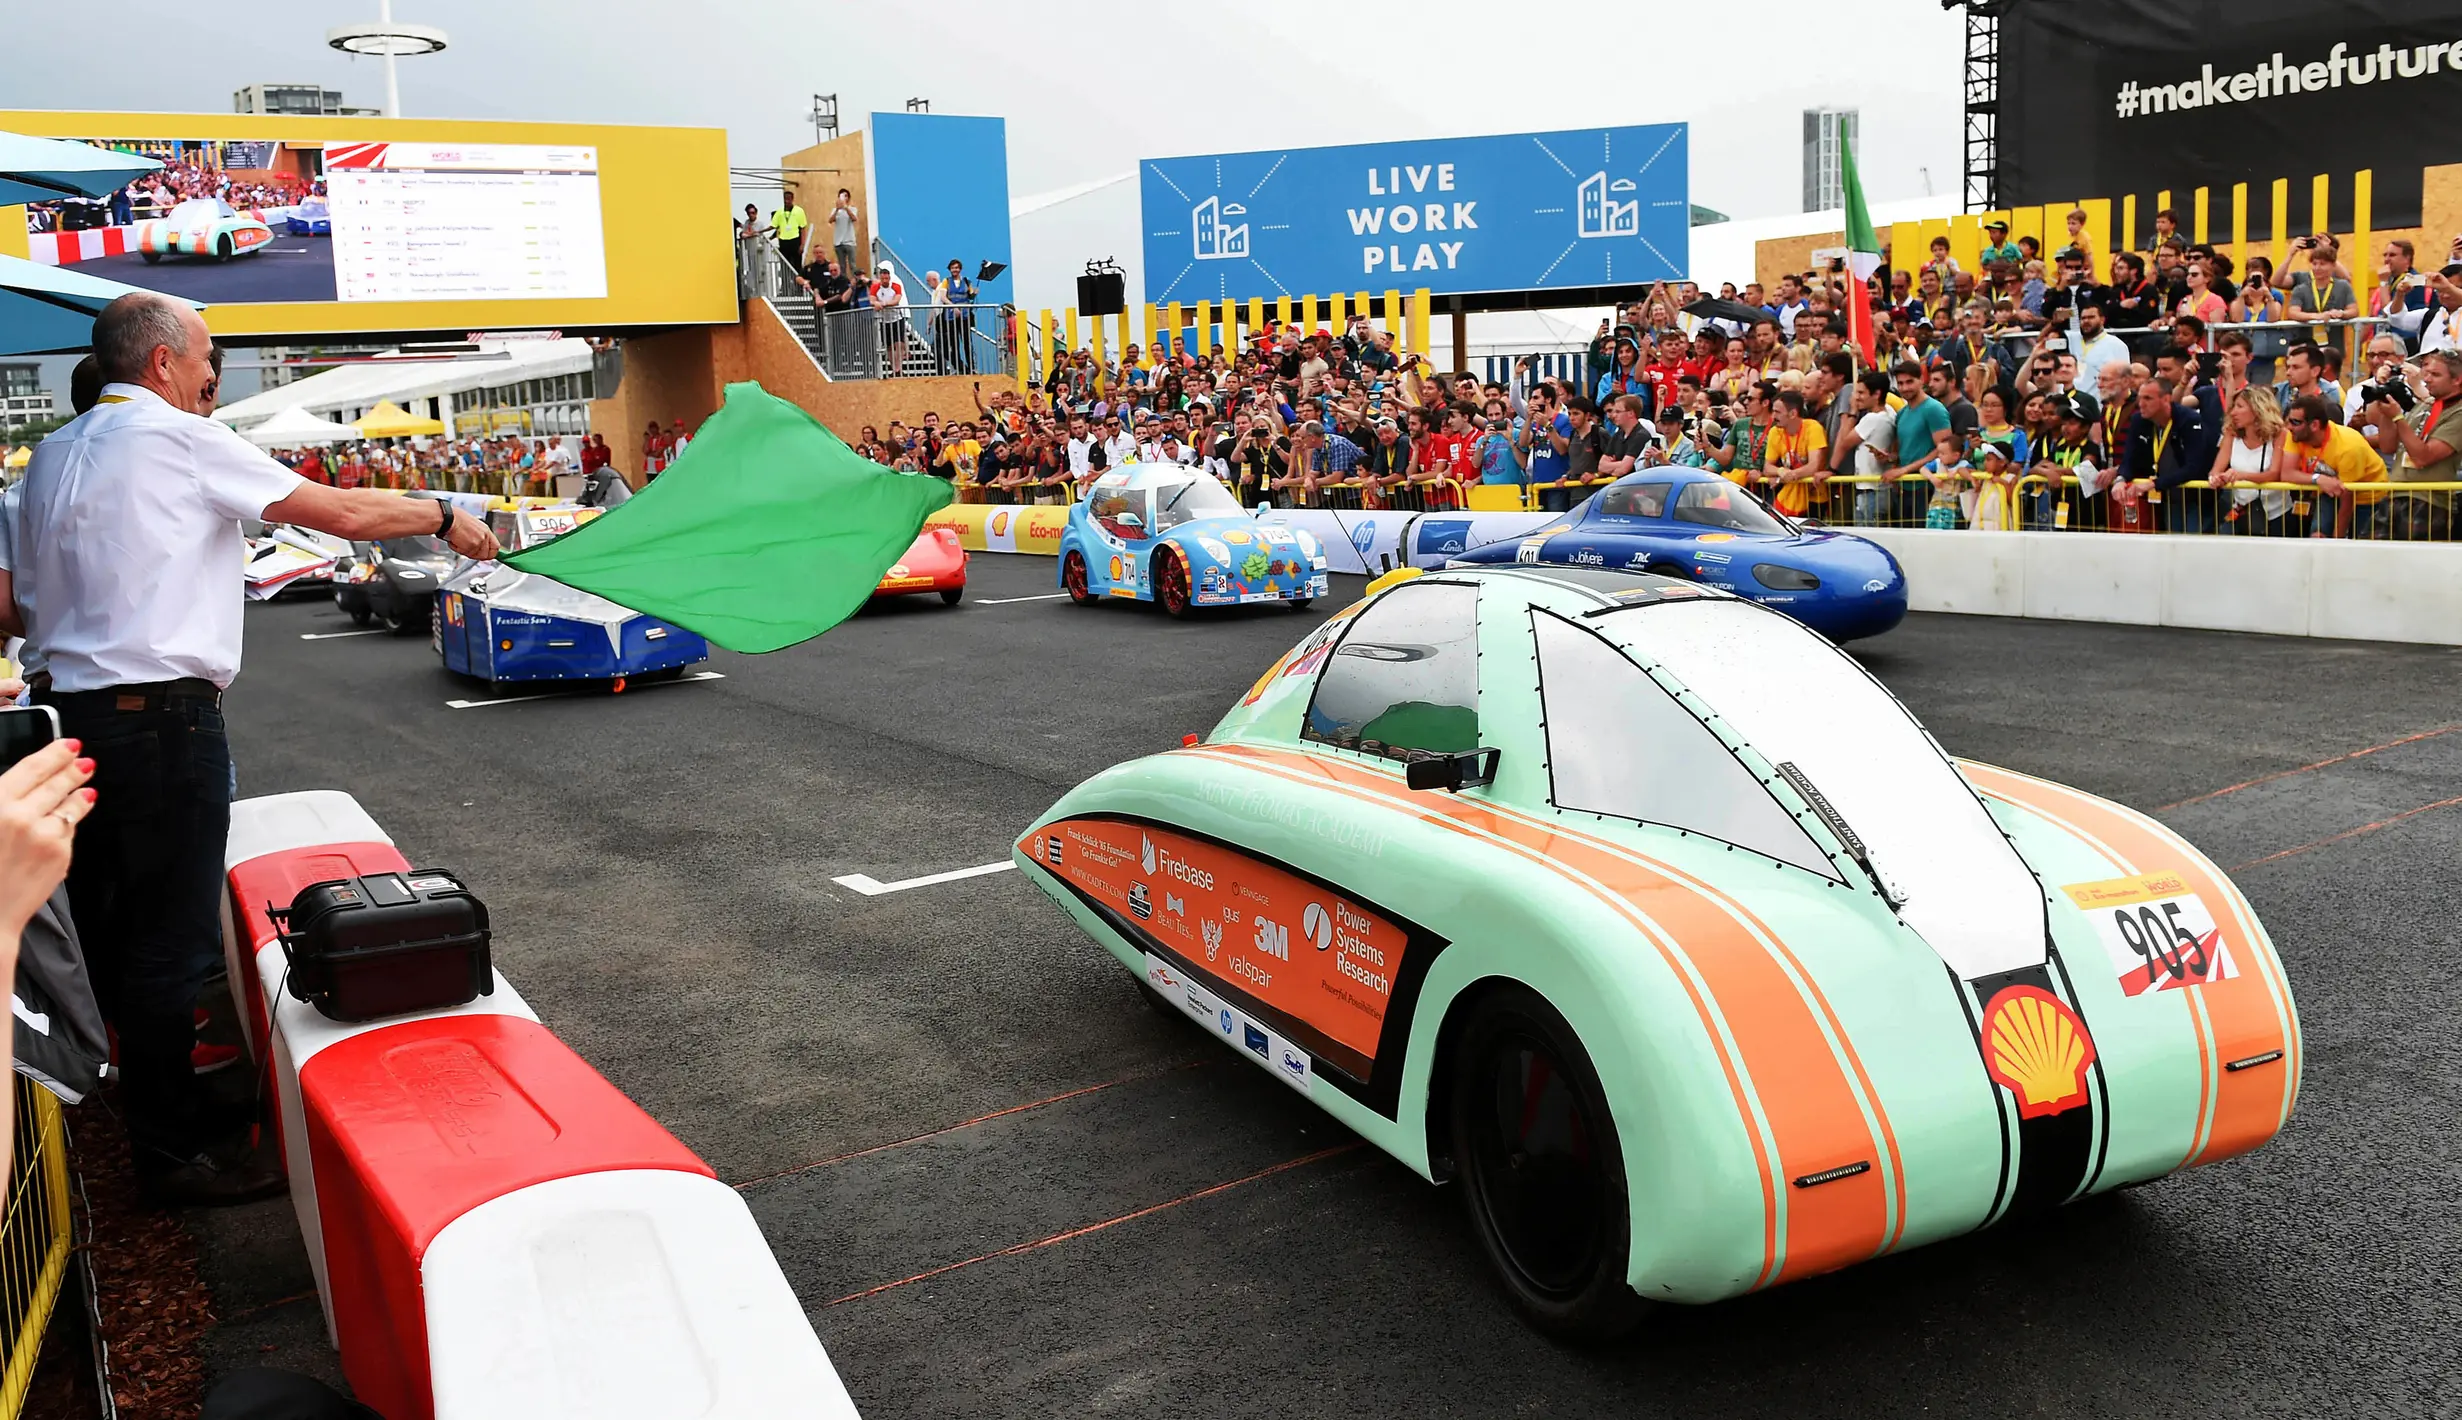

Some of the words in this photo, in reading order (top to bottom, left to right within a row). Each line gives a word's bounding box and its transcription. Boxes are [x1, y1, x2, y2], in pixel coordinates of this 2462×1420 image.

[1368, 163, 1455, 196] LIVE
[1346, 201, 1479, 236] WORK
[1363, 241, 1465, 274] PLAY
[540, 518, 567, 531] 906
[1353, 521, 1375, 552] hp
[1437, 540, 1465, 552] Linde
[1124, 563, 1135, 580] 704
[497, 616, 530, 625] Fantastic
[1784, 763, 1818, 796] ACADEMY
[1194, 779, 1236, 808] SAINT
[1241, 788, 1305, 828] THOMAS
[1307, 812, 1391, 858] ACADEMY
[1814, 794, 1843, 826] THOMAS
[1067, 827, 1081, 840] Frank
[1107, 843, 1136, 862] Foundation
[1841, 827, 1863, 849] SAINT
[1089, 852, 1109, 865] Frankie
[1160, 848, 1214, 891] Firebase
[1071, 865, 1125, 901] WWW.CADETS.COM
[1240, 885, 1270, 907] VENNGAGE
[1157, 909, 1176, 930] BEAU
[1176, 918, 1190, 939] TIES
[1336, 902, 1371, 936] Power
[1253, 915, 1289, 962] 3M
[1336, 926, 1384, 967] Systems
[2115, 902, 2207, 984] 905
[1228, 954, 1272, 989] valspar
[1337, 951, 1389, 996] Research
[1321, 979, 1348, 1002] Powerful
[1347, 994, 1384, 1021] Possibilities
[1221, 1009, 1233, 1034] hp
[1284, 1053, 1304, 1076] SwRI
